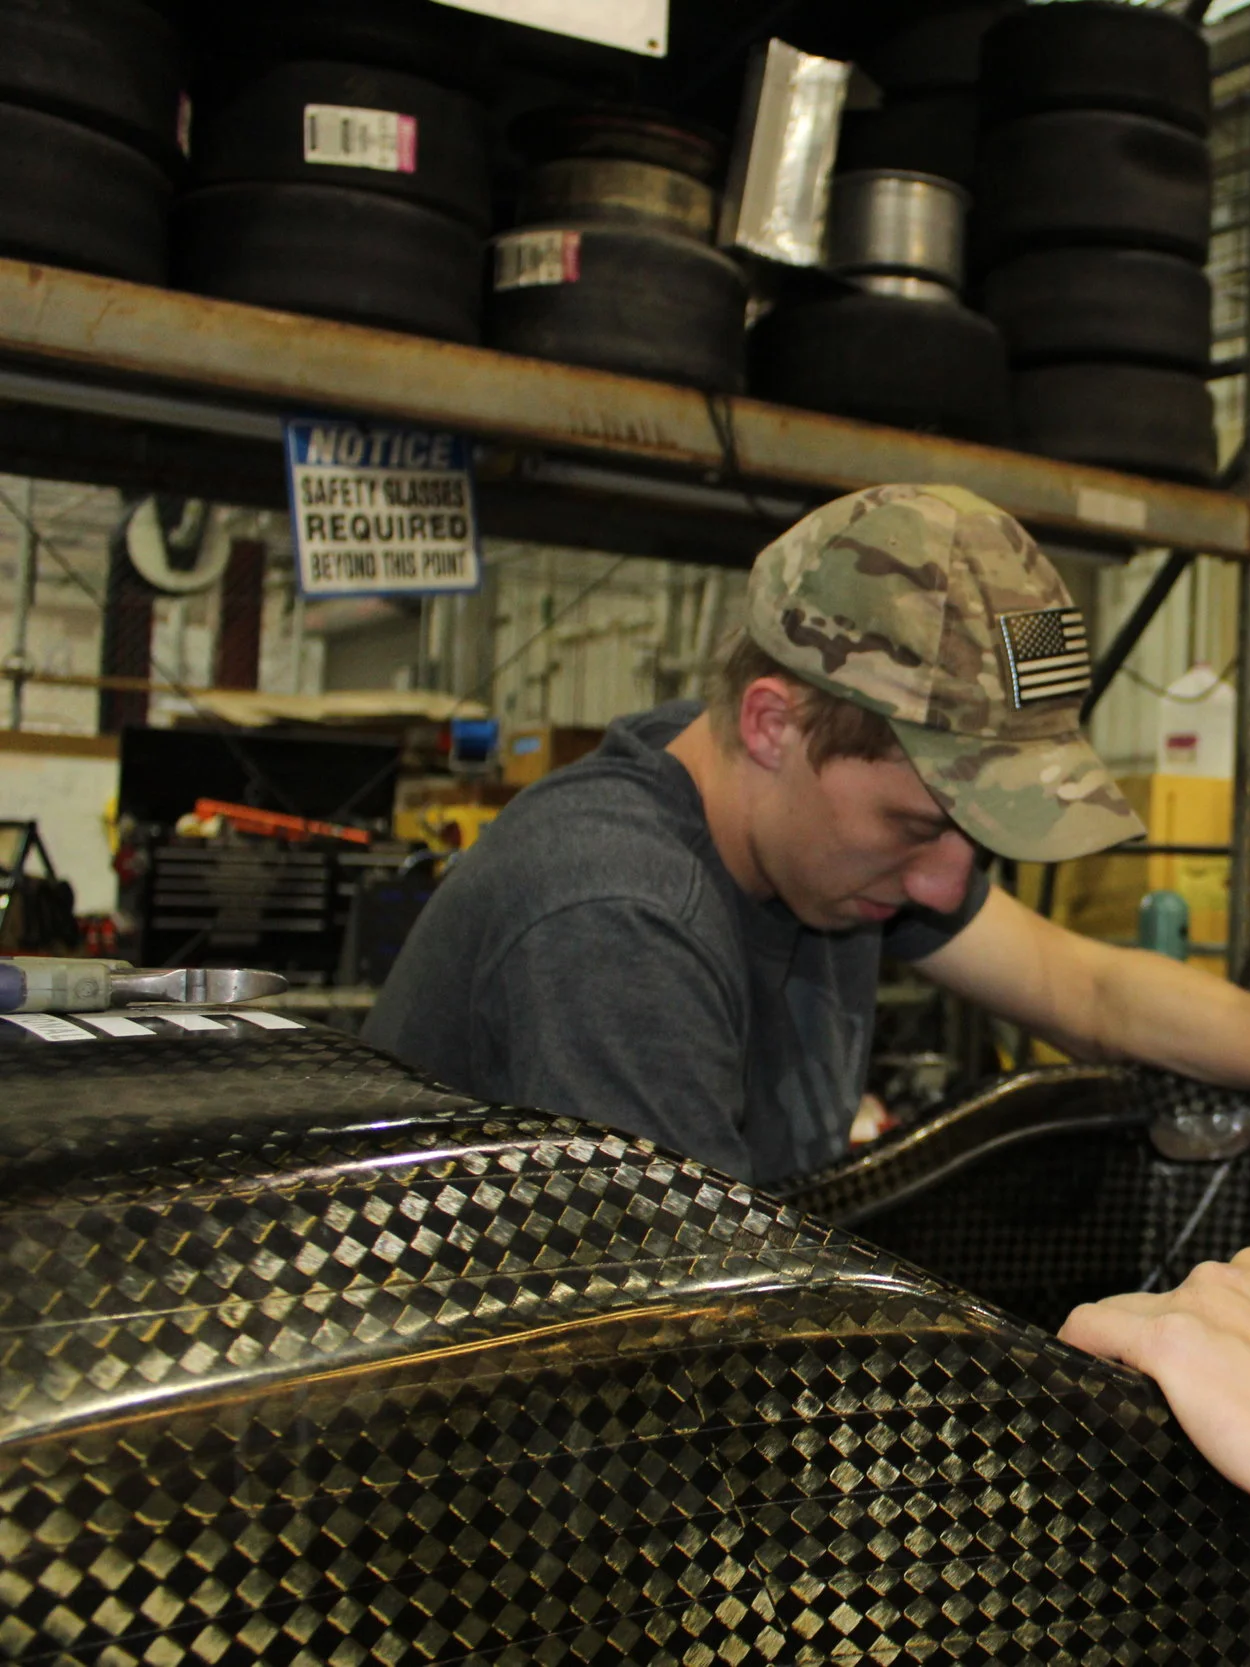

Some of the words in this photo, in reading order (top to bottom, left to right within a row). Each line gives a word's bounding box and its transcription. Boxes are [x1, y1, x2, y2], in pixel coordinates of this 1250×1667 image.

[306, 425, 454, 468] NOTICE
[301, 475, 376, 506] SAFETY
[383, 478, 465, 508] GLASSES
[306, 513, 468, 542] REQUIRED
[311, 550, 376, 581] BEYOND
[382, 550, 416, 580] THIS
[421, 551, 466, 577] POINT
